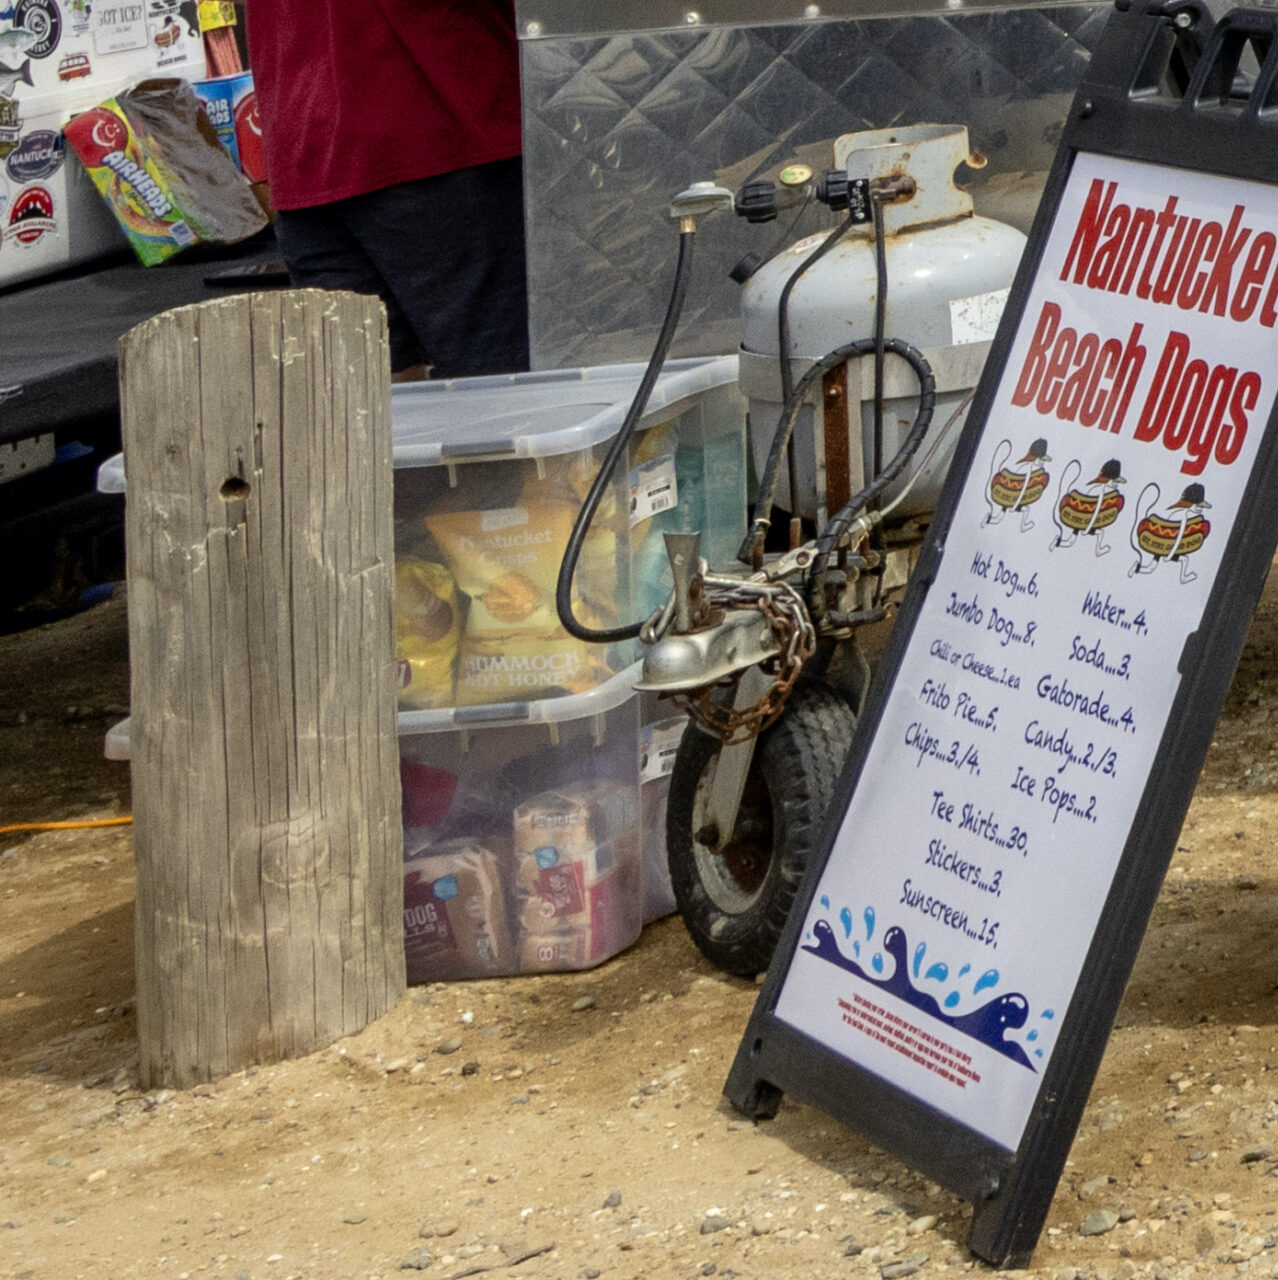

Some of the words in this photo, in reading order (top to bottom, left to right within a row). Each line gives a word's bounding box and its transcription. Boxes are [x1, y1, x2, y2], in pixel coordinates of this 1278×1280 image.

[101, 151, 173, 219] AIRHEADS
[1010, 301, 1147, 434] Beach
[1133, 330, 1261, 476] Dogs
[970, 551, 993, 576] Hot
[946, 592, 983, 625] Jumbo
[951, 651, 961, 666] or
[919, 679, 950, 711] Frito
[1010, 766, 1036, 797] Ice
[930, 791, 955, 823] Tee
